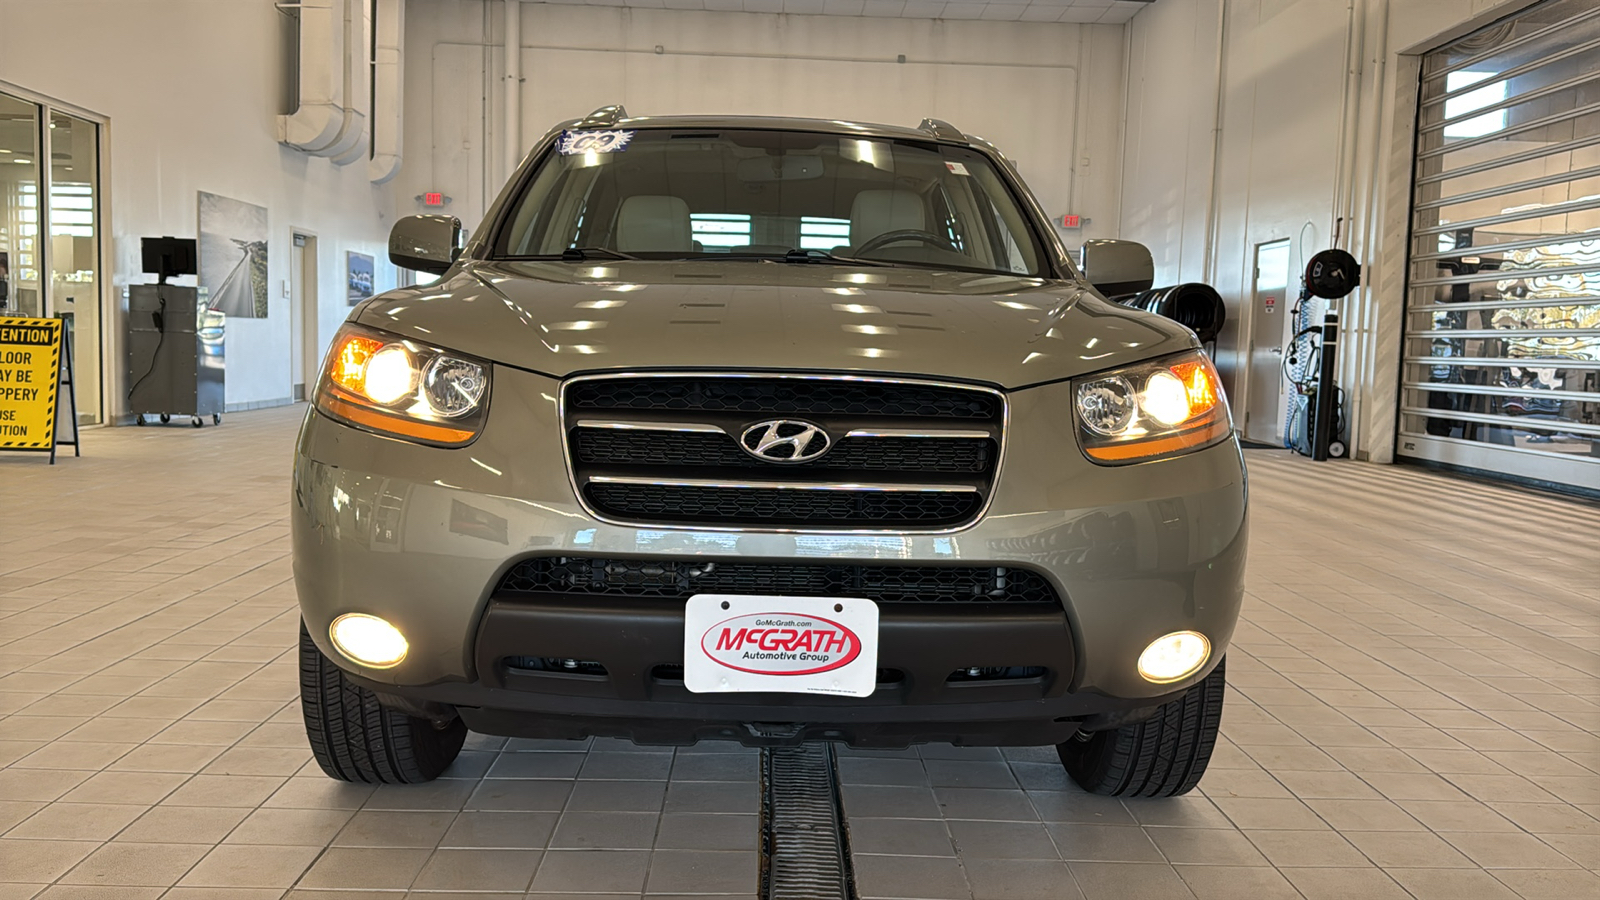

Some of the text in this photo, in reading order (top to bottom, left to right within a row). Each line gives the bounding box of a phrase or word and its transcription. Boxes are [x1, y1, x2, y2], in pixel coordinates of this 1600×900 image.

[426, 192, 442, 206] EXIT
[1064, 214, 1079, 227] EXIT
[0, 328, 49, 343] ENTION
[16, 369, 33, 383] BE
[0, 410, 16, 421] SE
[755, 619, 812, 627] GoMcGrath.com
[742, 651, 830, 663] Automotive Group
